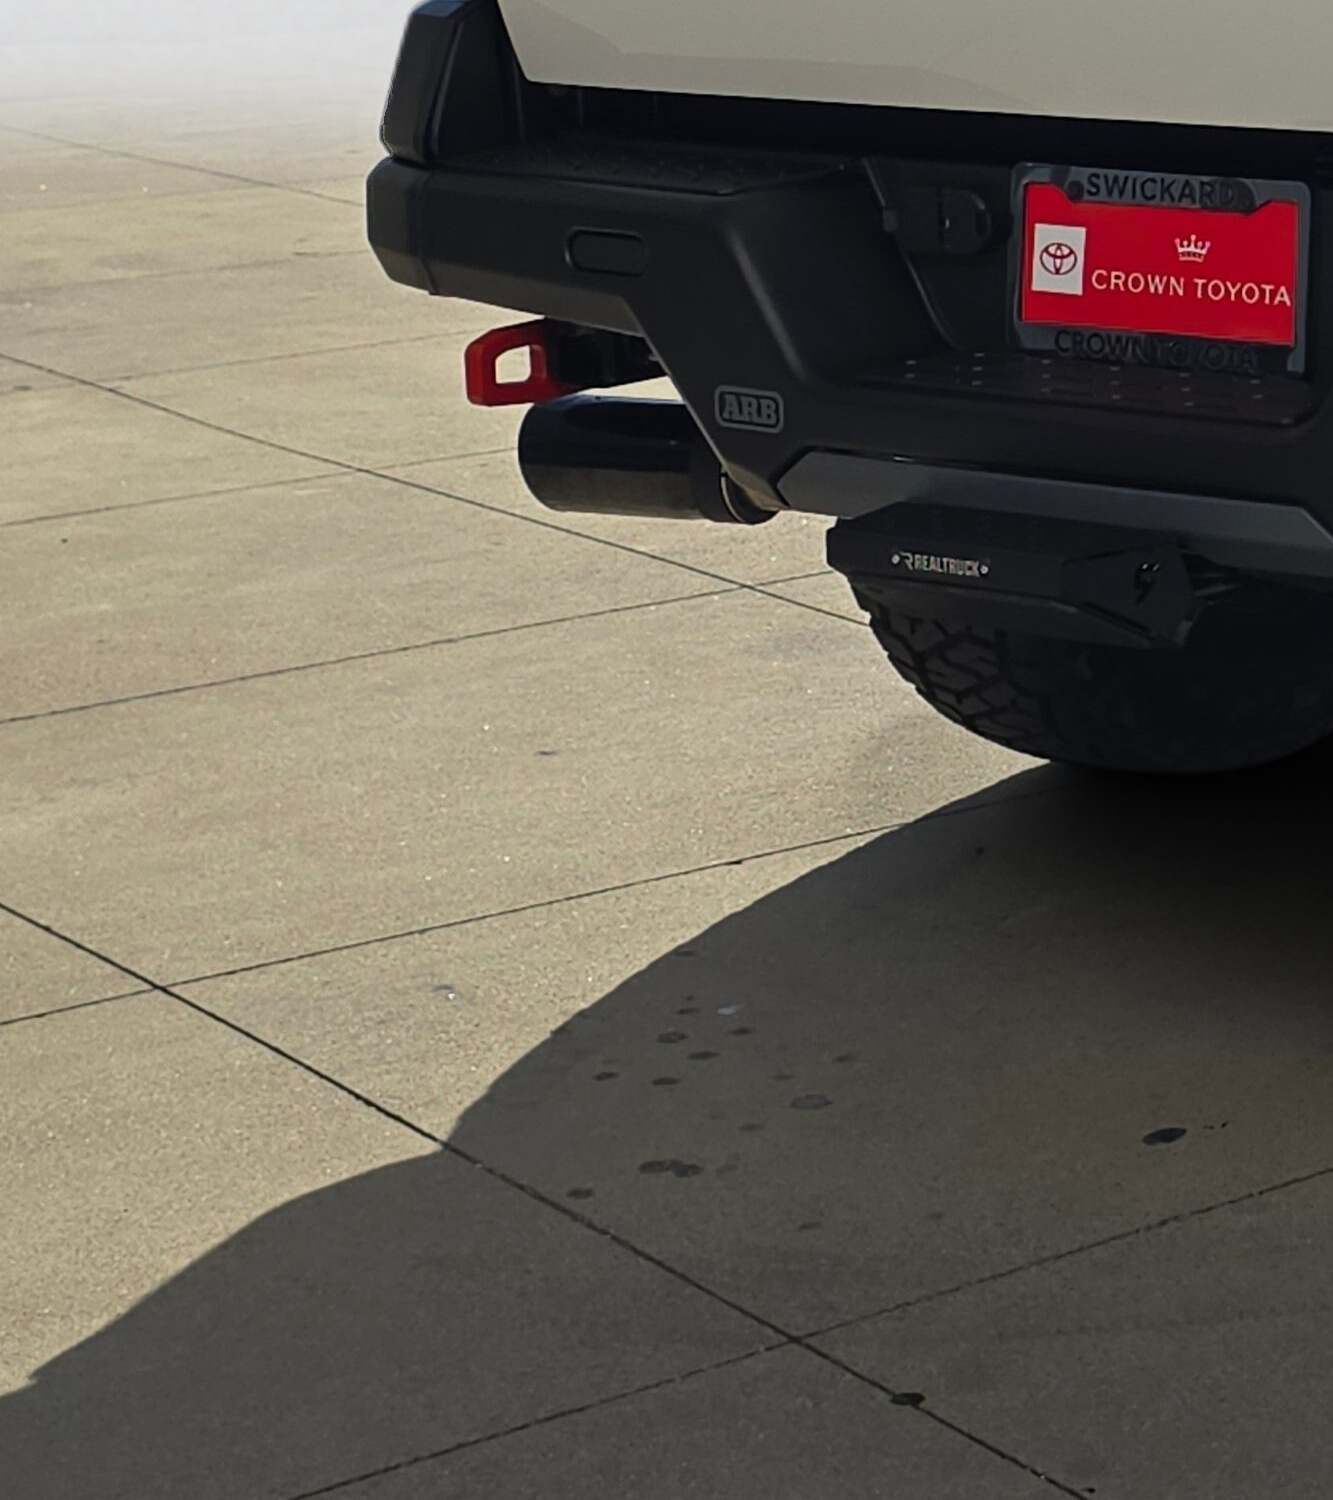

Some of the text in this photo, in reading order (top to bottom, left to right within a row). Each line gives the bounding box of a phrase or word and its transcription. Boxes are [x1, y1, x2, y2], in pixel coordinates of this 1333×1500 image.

[1085, 171, 1236, 207] SWICKARD
[1090, 269, 1292, 308] CROWN TOYOTA
[1054, 329, 1150, 364] CROWN
[722, 393, 777, 425] ARB
